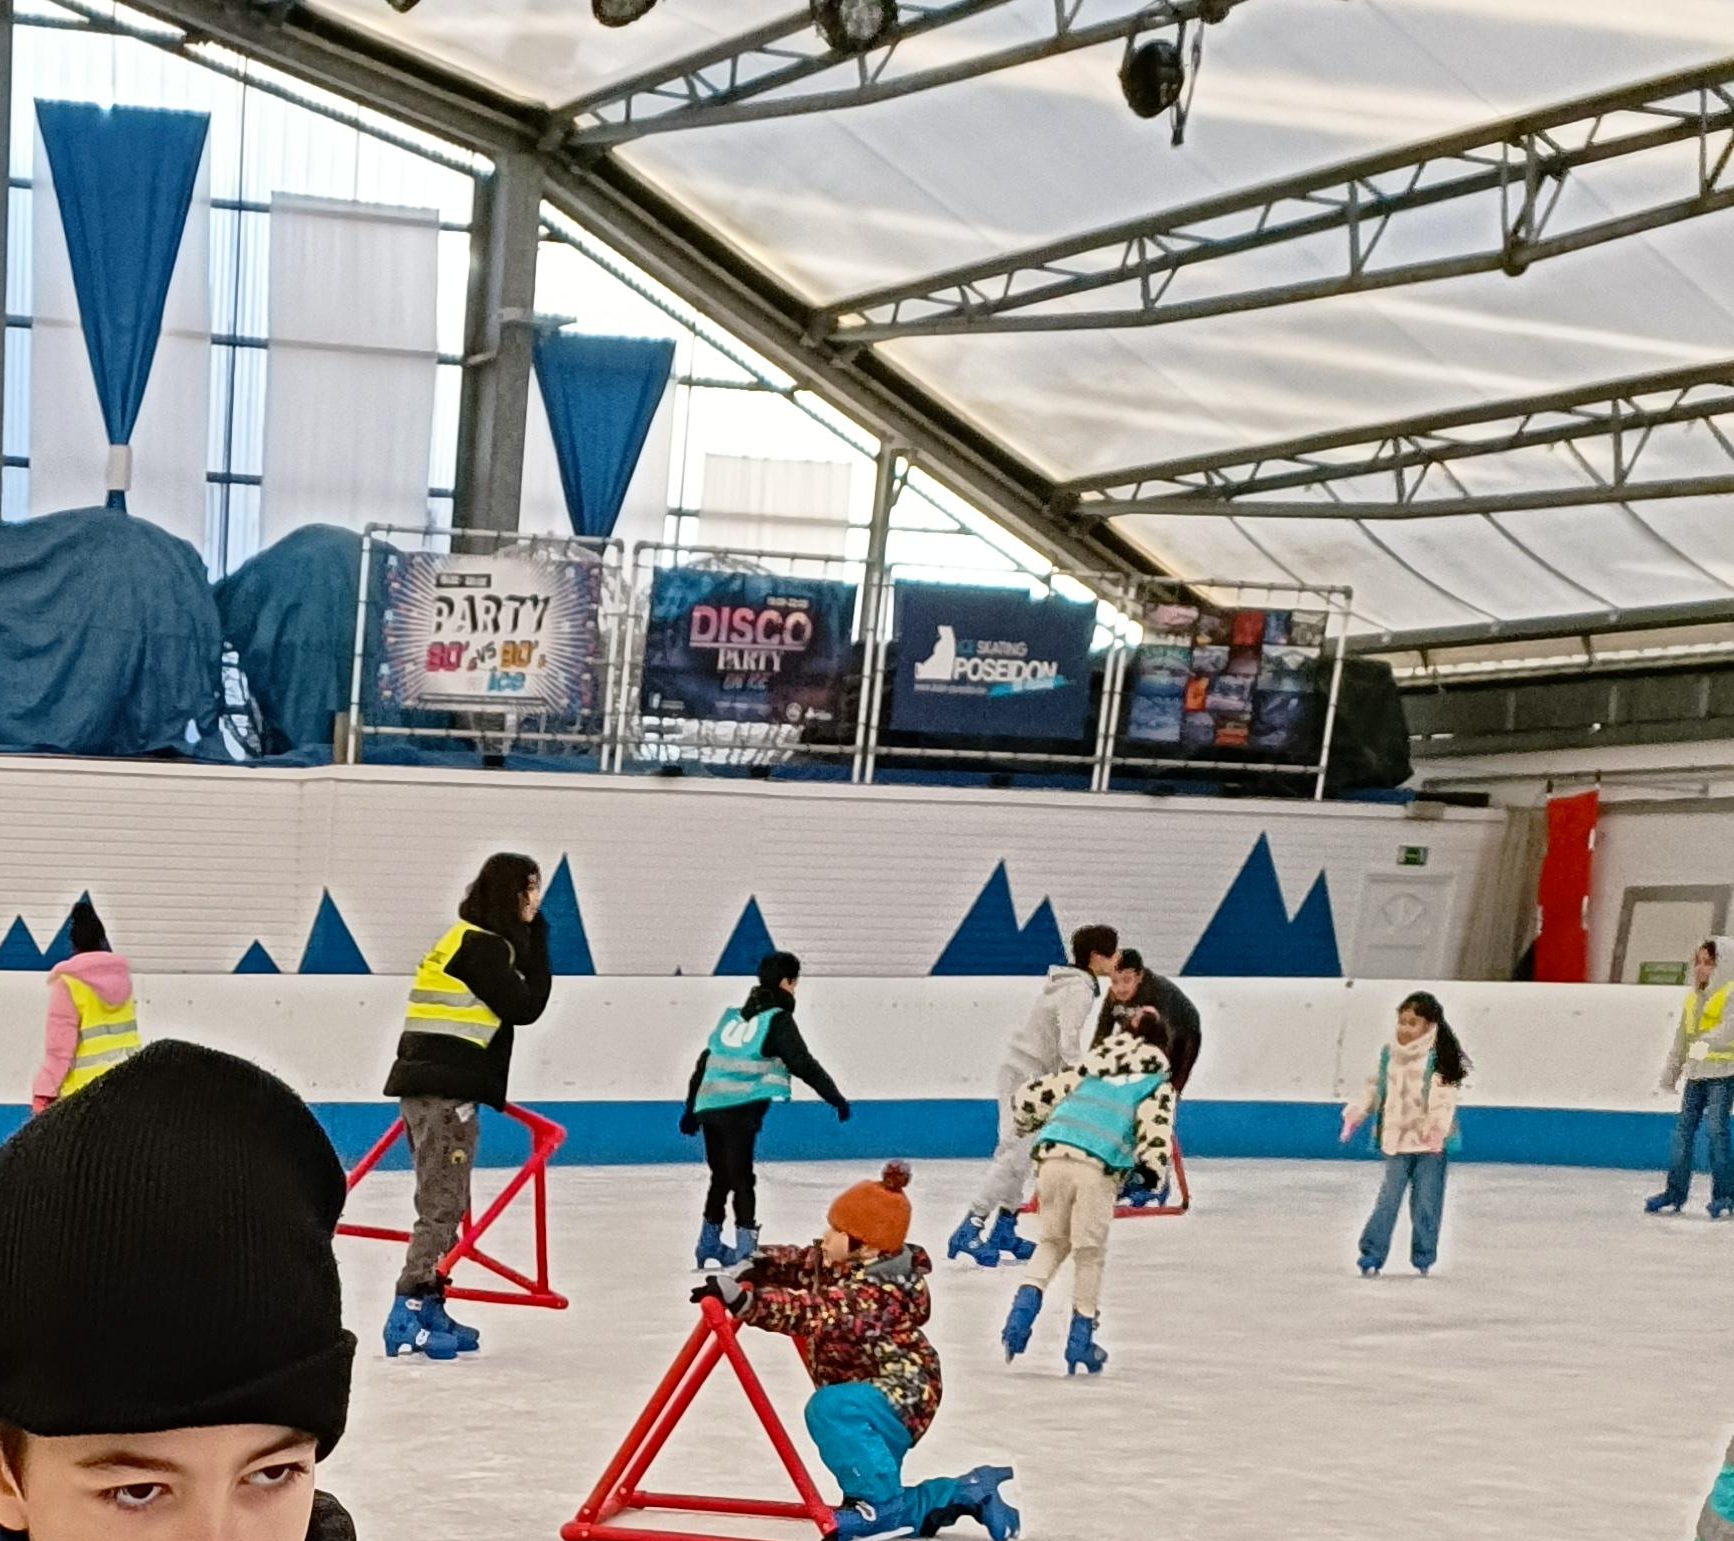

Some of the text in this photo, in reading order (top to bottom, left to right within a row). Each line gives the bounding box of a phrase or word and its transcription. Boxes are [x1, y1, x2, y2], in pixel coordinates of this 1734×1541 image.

[432, 594, 550, 634] PARTY
[690, 604, 813, 646] DISCO
[717, 648, 782, 672] PARTY
[977, 640, 1028, 657] SKATING
[953, 657, 1058, 682] POSEIDON
